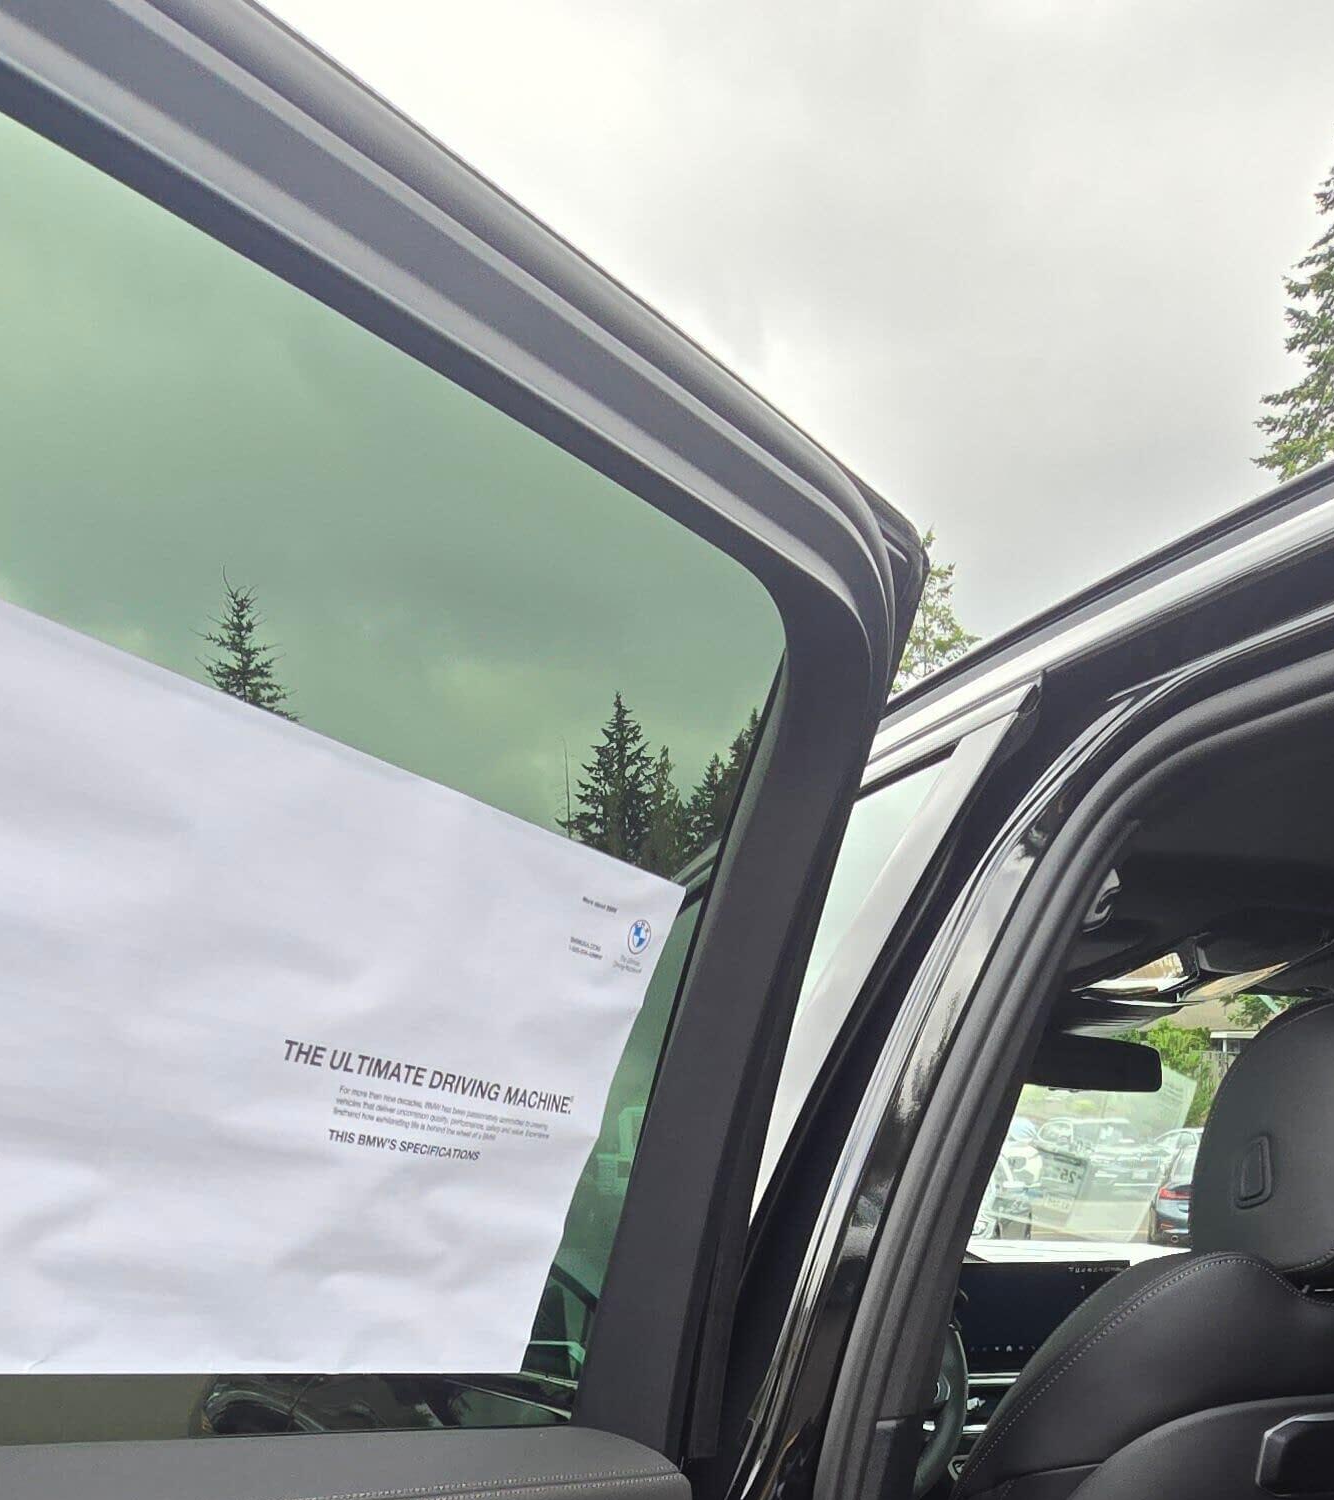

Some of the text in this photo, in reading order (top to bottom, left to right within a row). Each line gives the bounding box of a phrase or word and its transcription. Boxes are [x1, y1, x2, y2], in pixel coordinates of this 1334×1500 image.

[284, 1039, 326, 1067] THE
[329, 1049, 427, 1087] ULTIMATE
[428, 1070, 501, 1102] DRIVING
[339, 1085, 351, 1095] For
[351, 1088, 368, 1098] more
[368, 1091, 383, 1100] than
[328, 1129, 480, 1161] THIS BMW'S SPECIFICATIONS
